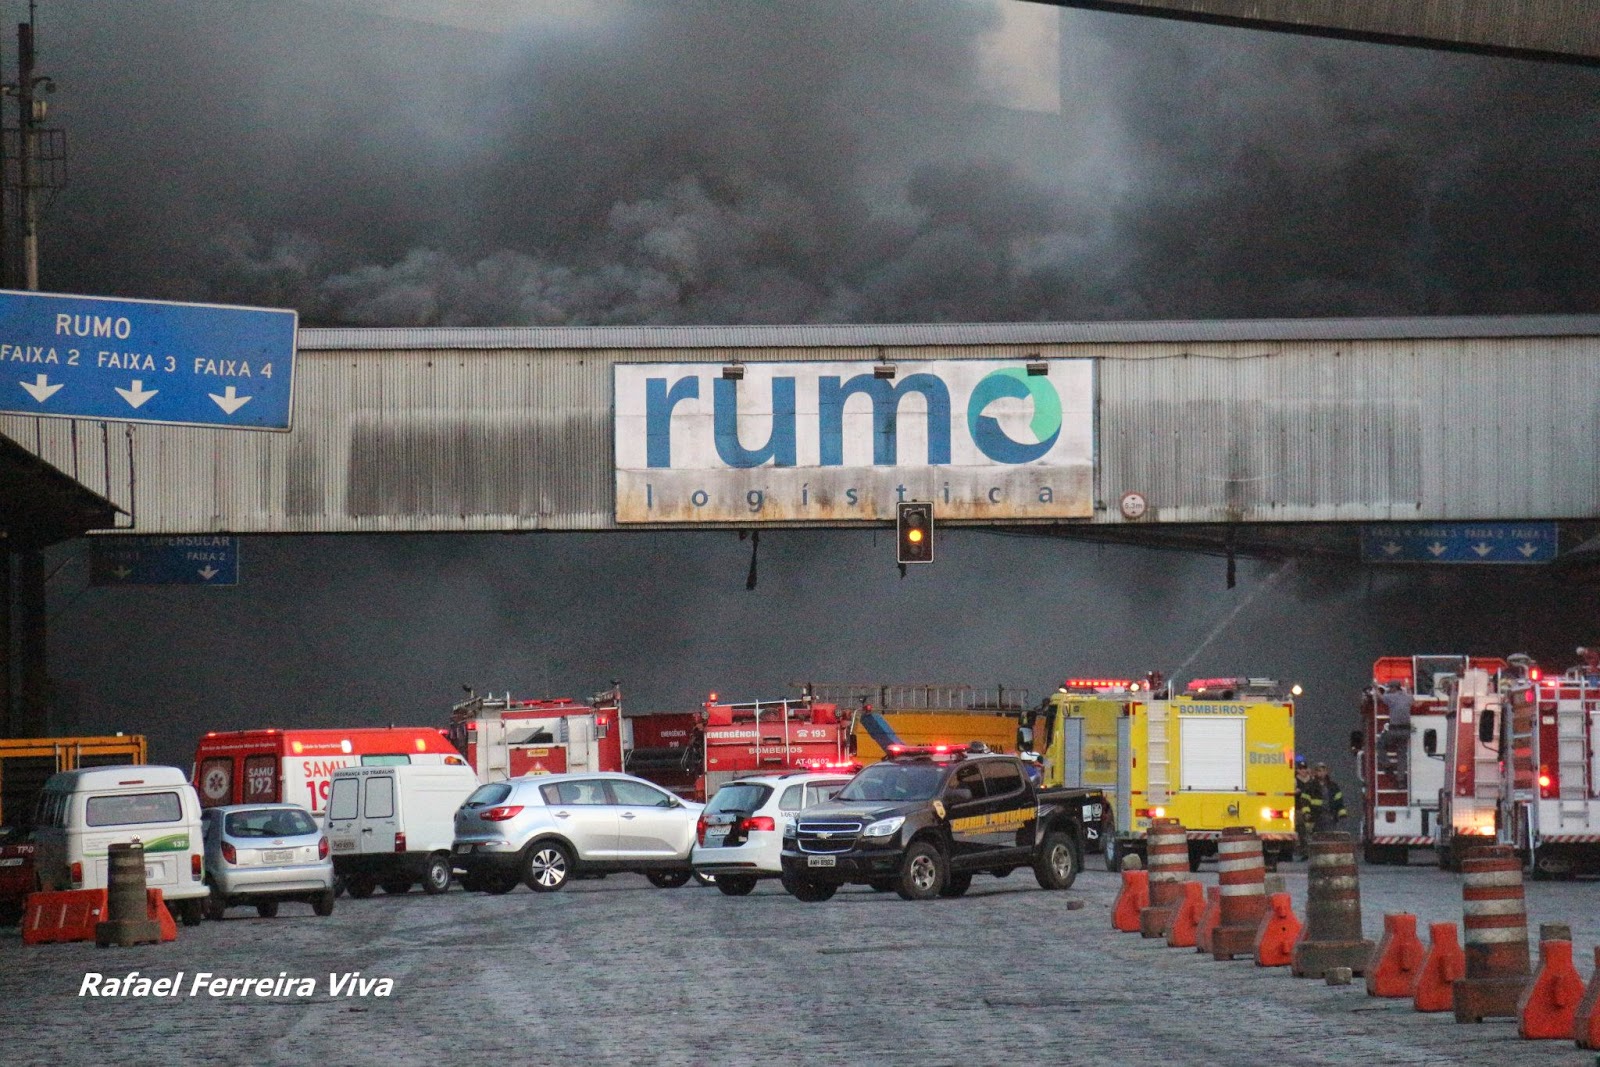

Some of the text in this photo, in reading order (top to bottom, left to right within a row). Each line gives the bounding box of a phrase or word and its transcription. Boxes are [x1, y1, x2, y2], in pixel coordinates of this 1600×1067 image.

[55, 313, 131, 340] RUMO
[1, 343, 80, 367] FAIXA 2
[97, 350, 177, 374] FAIXA 3
[194, 357, 273, 380] FAIXA 4
[645, 366, 1064, 469] rumo
[646, 482, 1054, 509] logística
[187, 551, 227, 562] FAIXA 2
[1179, 704, 1247, 716] BOMBEIROS
[707, 729, 760, 741] EMERGÊNCIA
[810, 729, 827, 740] 193
[749, 746, 803, 756] BOMBEIROS
[1249, 751, 1286, 766] Brasil
[248, 766, 275, 778] SAMU
[334, 768, 396, 778] SEGURANÇA DO TRABALHO
[248, 777, 273, 795] 192
